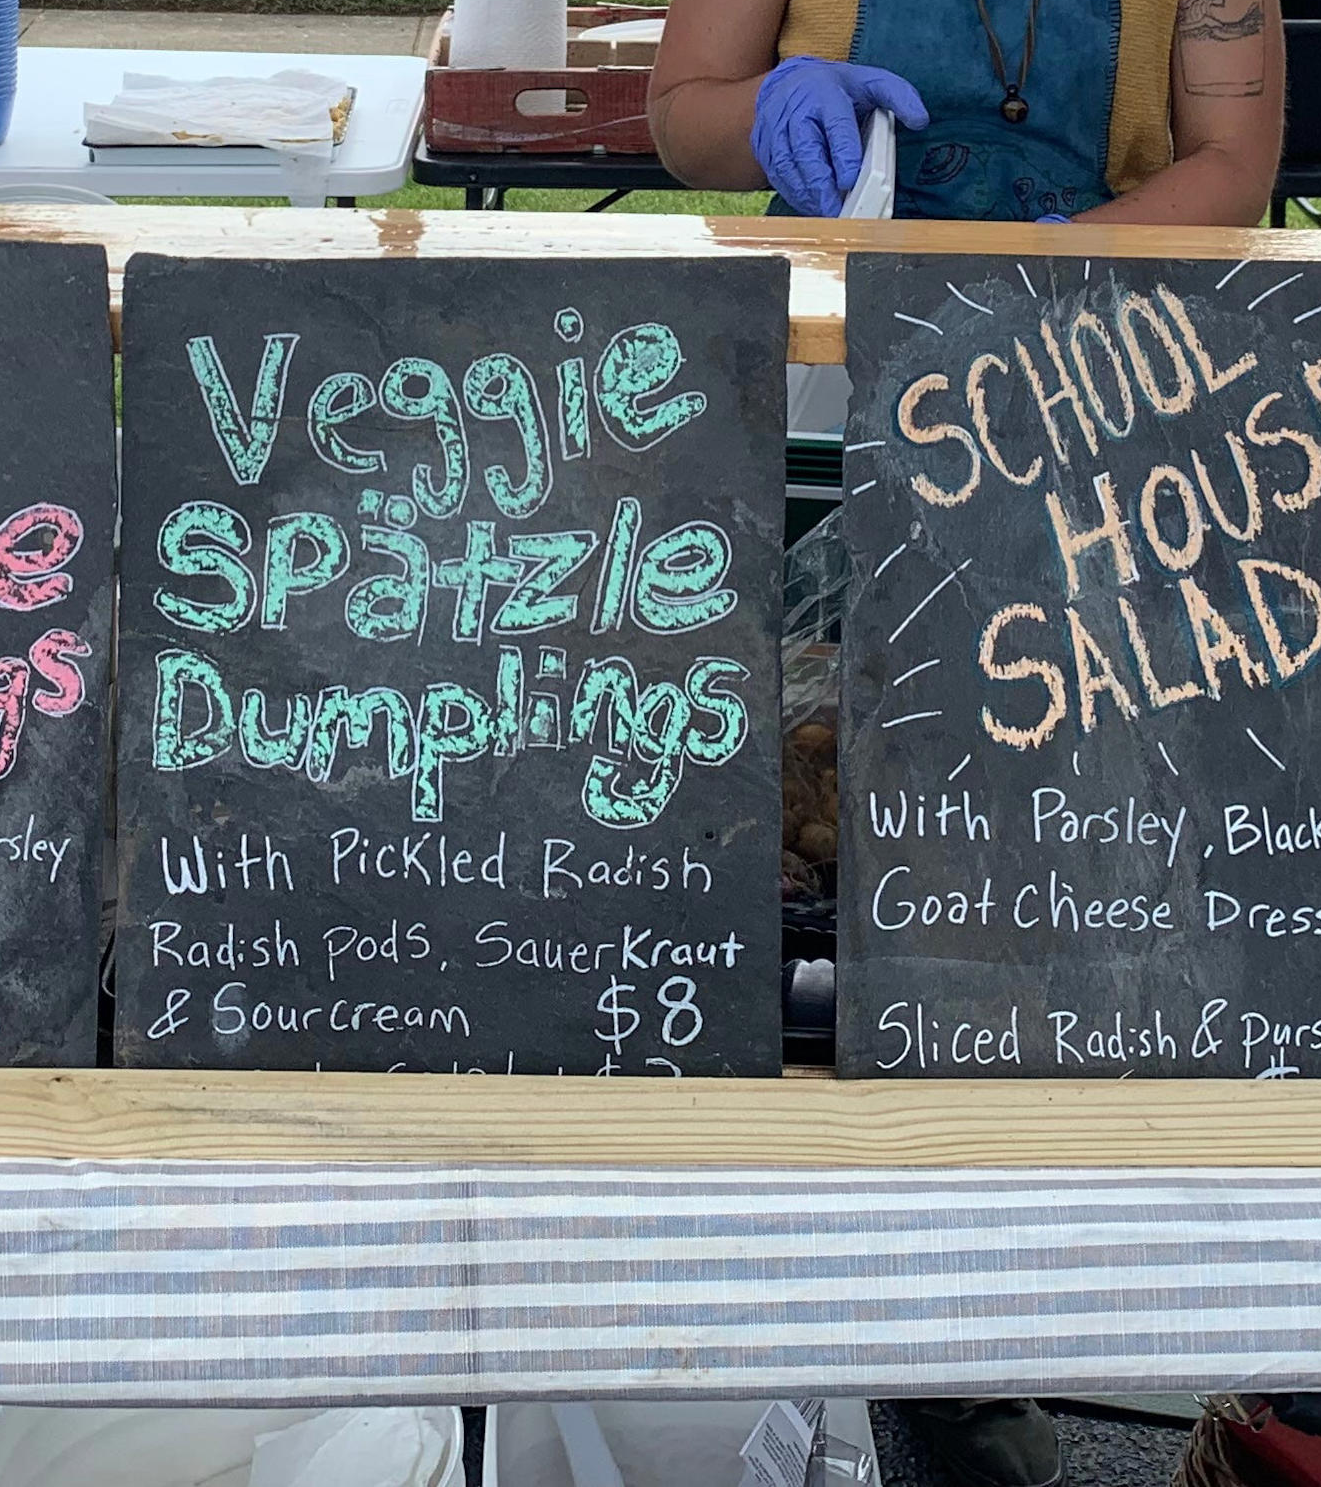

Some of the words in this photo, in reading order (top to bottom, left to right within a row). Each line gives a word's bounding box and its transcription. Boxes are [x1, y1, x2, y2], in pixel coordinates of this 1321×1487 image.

[186, 307, 707, 518] Veggie
[896, 282, 1257, 508] SCHOOL
[153, 646, 751, 829] Dumplings
[870, 790, 990, 841] With
[159, 832, 294, 894] With
[543, 838, 713, 899] Radish
[872, 865, 996, 931] Goat
[149, 921, 299, 970] Radish
[146, 988, 190, 1039] &
[876, 1002, 1021, 1069] Sliced
[1047, 1011, 1178, 1064] Radish
[1191, 998, 1229, 1057] &
